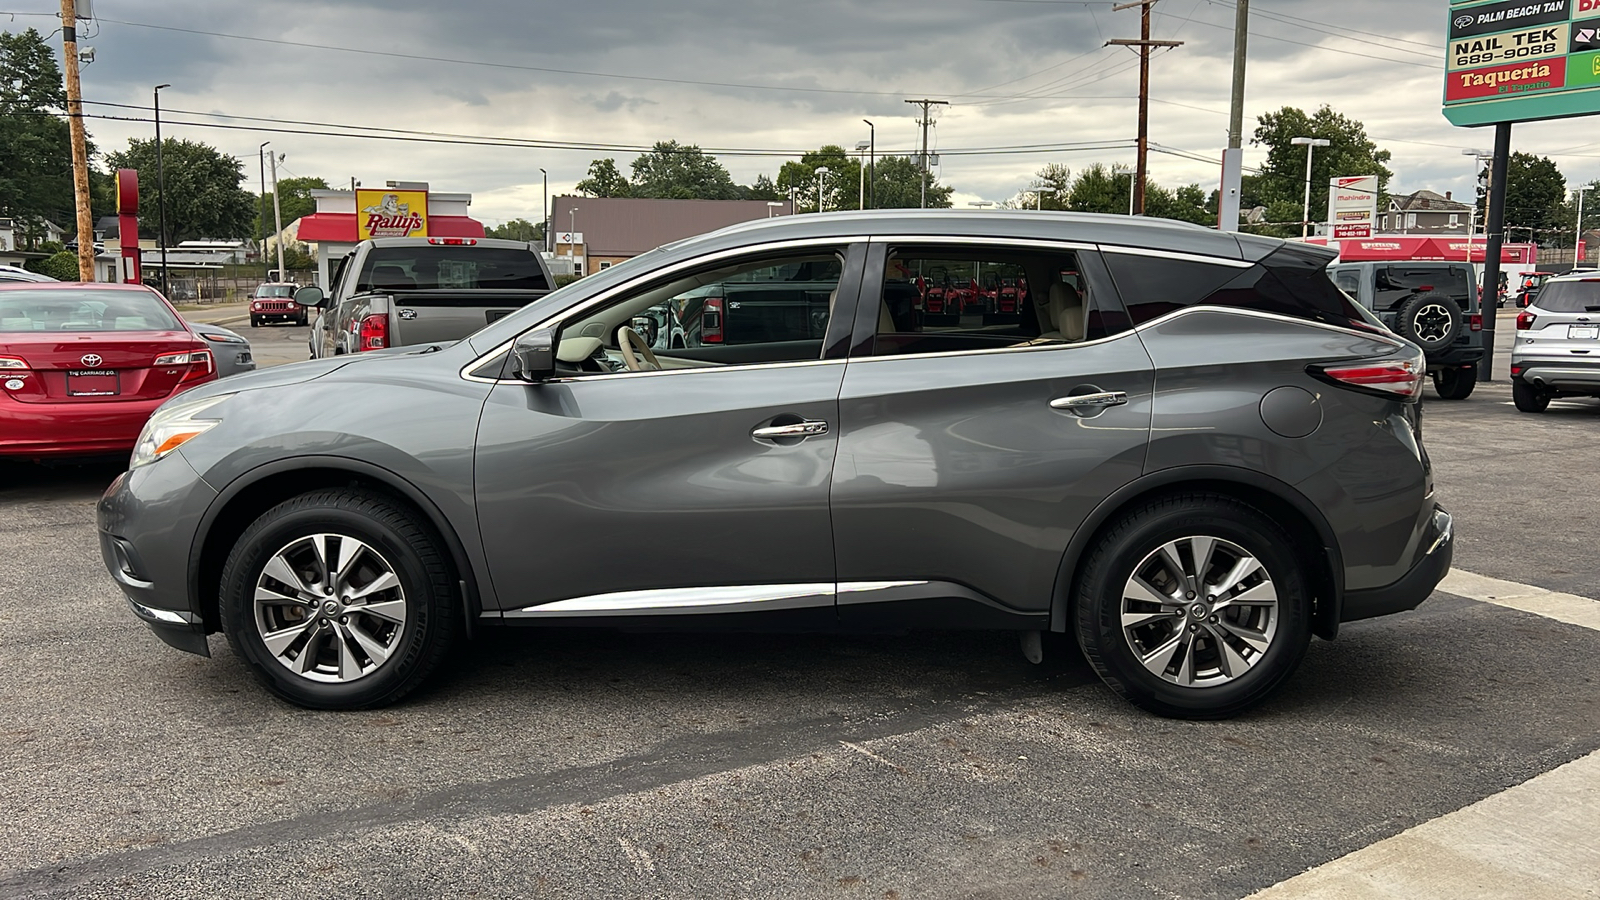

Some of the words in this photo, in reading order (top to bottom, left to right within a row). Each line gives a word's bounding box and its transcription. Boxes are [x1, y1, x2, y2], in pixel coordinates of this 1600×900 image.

[1477, 10, 1505, 24] PALM
[1506, 4, 1541, 19] BEACH
[1543, 0, 1564, 13] TAN
[1455, 37, 1503, 55] NAIL
[1512, 28, 1558, 46] TEK
[1457, 43, 1556, 66] 689-9088
[364, 212, 424, 237] Rally's
